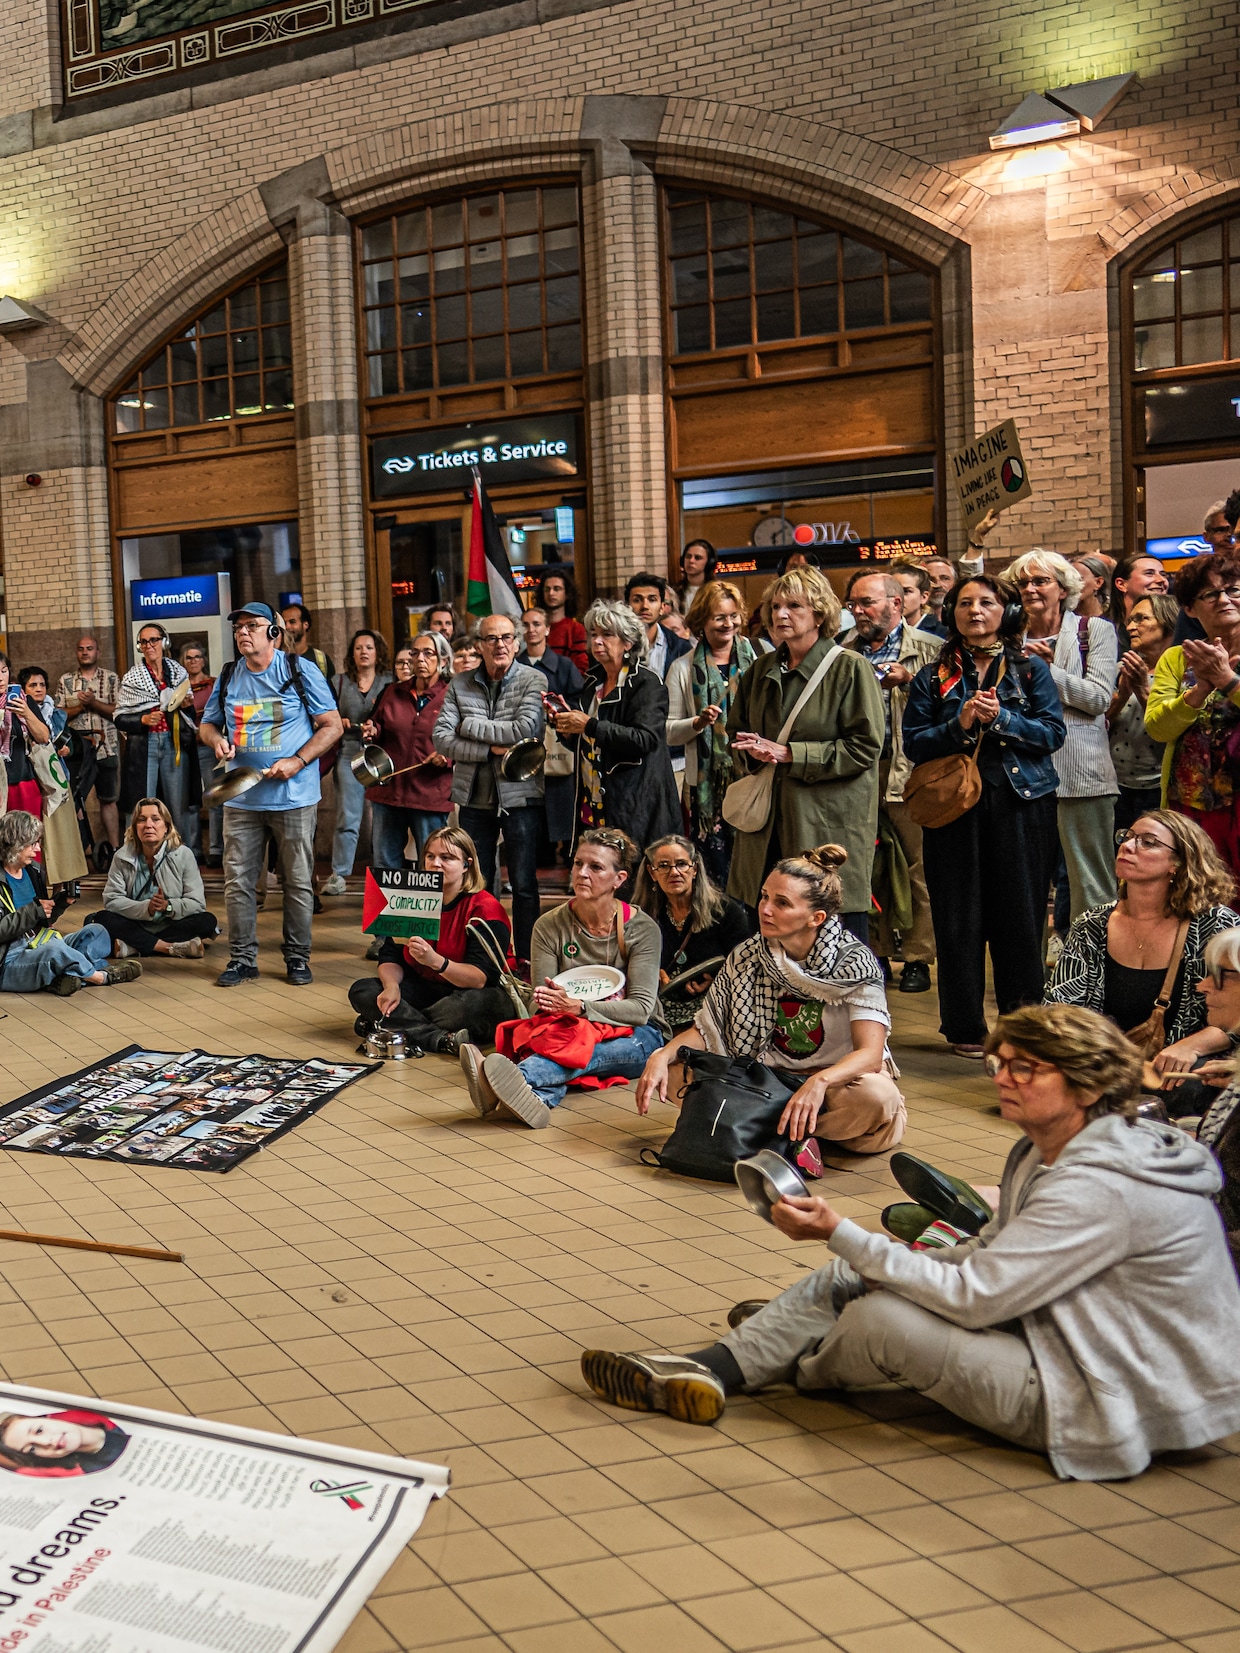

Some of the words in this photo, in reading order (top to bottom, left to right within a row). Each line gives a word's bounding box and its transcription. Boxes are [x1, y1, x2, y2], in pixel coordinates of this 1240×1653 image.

[418, 449, 479, 471] Tickets
[482, 446, 498, 463] &
[500, 439, 567, 461] Service
[953, 429, 1008, 477] IMAGINE
[965, 501, 975, 515] IN
[976, 487, 1000, 510] PEACE
[140, 590, 202, 606] Informatie
[382, 871, 401, 885] NO
[407, 871, 440, 888] MORE
[389, 895, 440, 911] COMPLICITY
[10, 1496, 127, 1585] dreams.
[15, 1612, 47, 1628] in
[33, 1547, 111, 1611] Palestine
